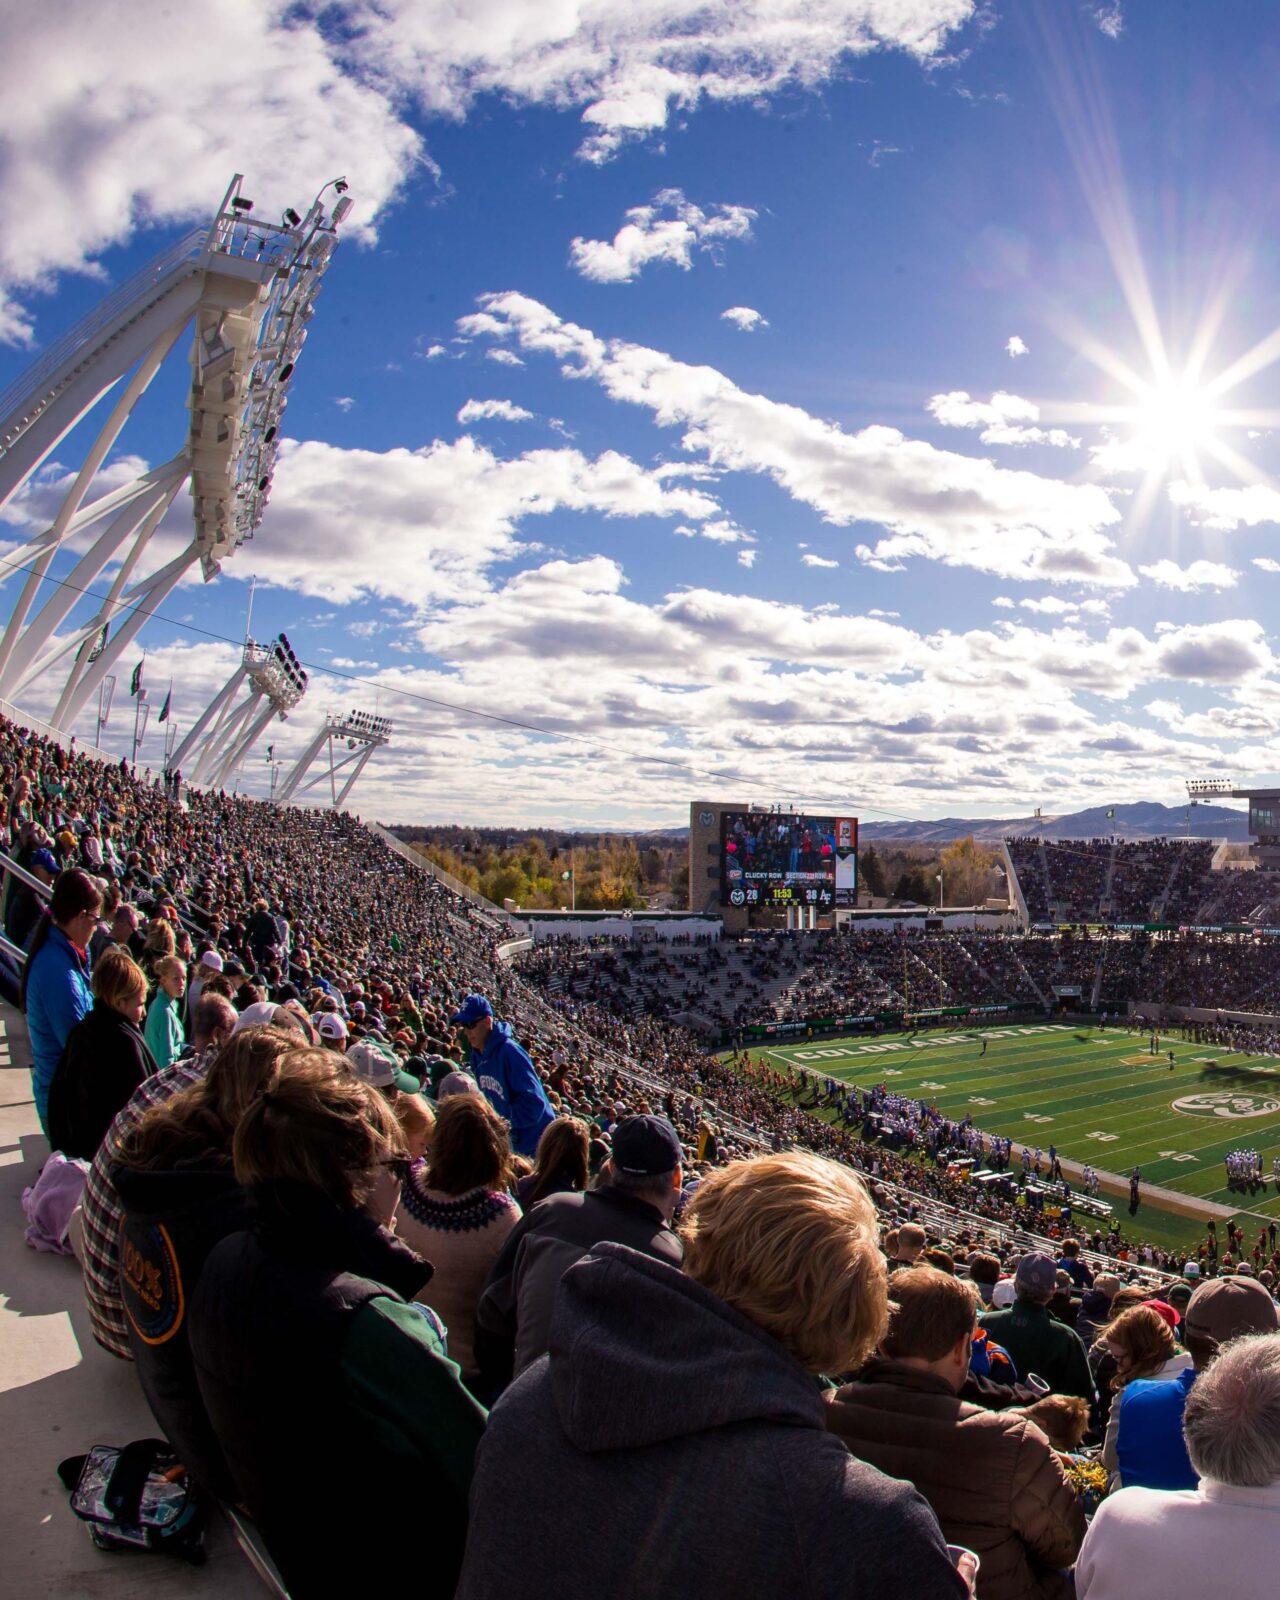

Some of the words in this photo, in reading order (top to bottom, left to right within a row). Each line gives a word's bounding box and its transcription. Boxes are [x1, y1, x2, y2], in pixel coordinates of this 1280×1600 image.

[773, 888, 792, 899] 11:53
[794, 1035, 976, 1060] COLORADO
[978, 1024, 1076, 1039] STATE
[1157, 1150, 1195, 1162] 40
